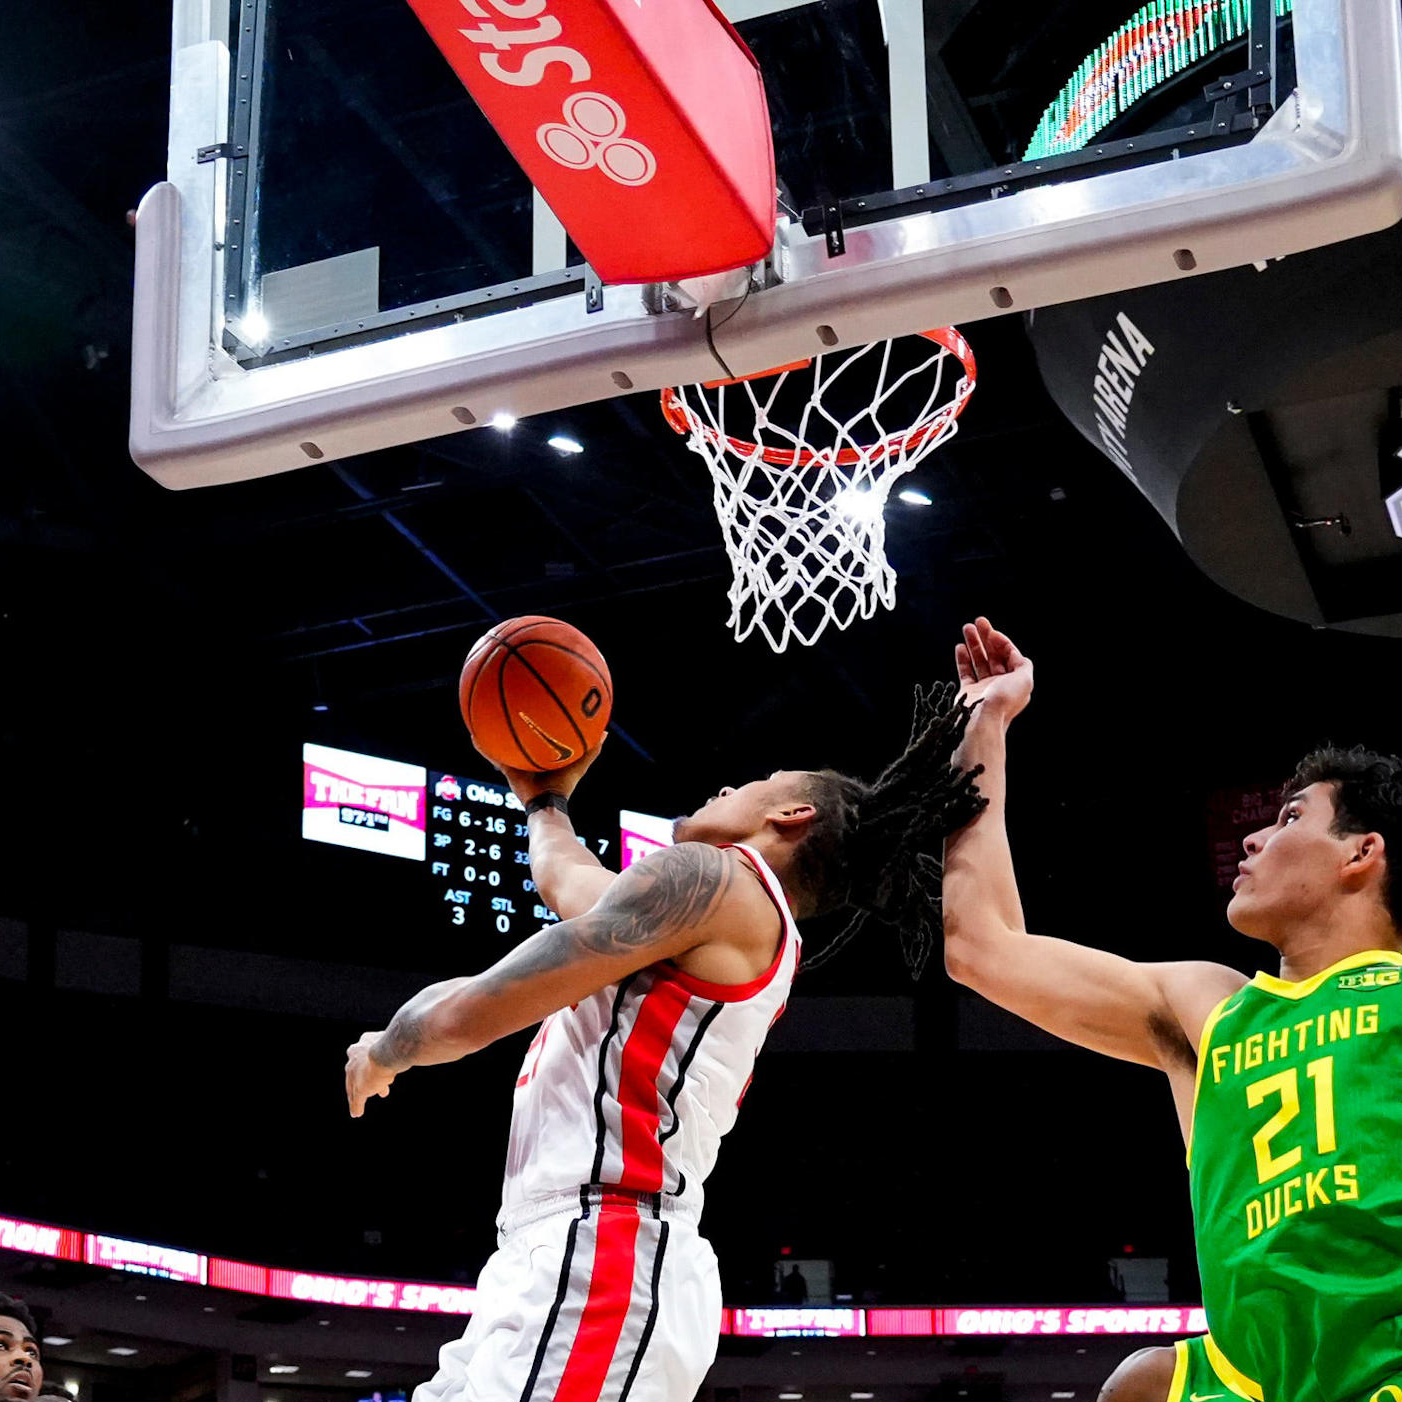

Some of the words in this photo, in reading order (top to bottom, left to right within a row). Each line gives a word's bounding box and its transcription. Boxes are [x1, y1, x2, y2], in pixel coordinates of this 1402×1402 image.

[1092, 311, 1156, 439] ARENA
[466, 783, 504, 807] Ohio
[432, 806, 453, 822] FG
[514, 823, 529, 837] 37
[433, 833, 452, 848] 3P
[514, 850, 529, 865] 33
[598, 838, 609, 855] 7
[432, 861, 451, 877] FT
[444, 888, 472, 904] AST
[491, 896, 517, 914] STL
[452, 906, 466, 926] 3
[496, 914, 510, 933] 0
[1211, 1003, 1380, 1084] FIGHTING
[1245, 1055, 1337, 1185] 21
[1245, 1164, 1359, 1240] DUCKS
[956, 1308, 1062, 1334] OHIO'S
[1064, 1308, 1182, 1334] SPORTS
